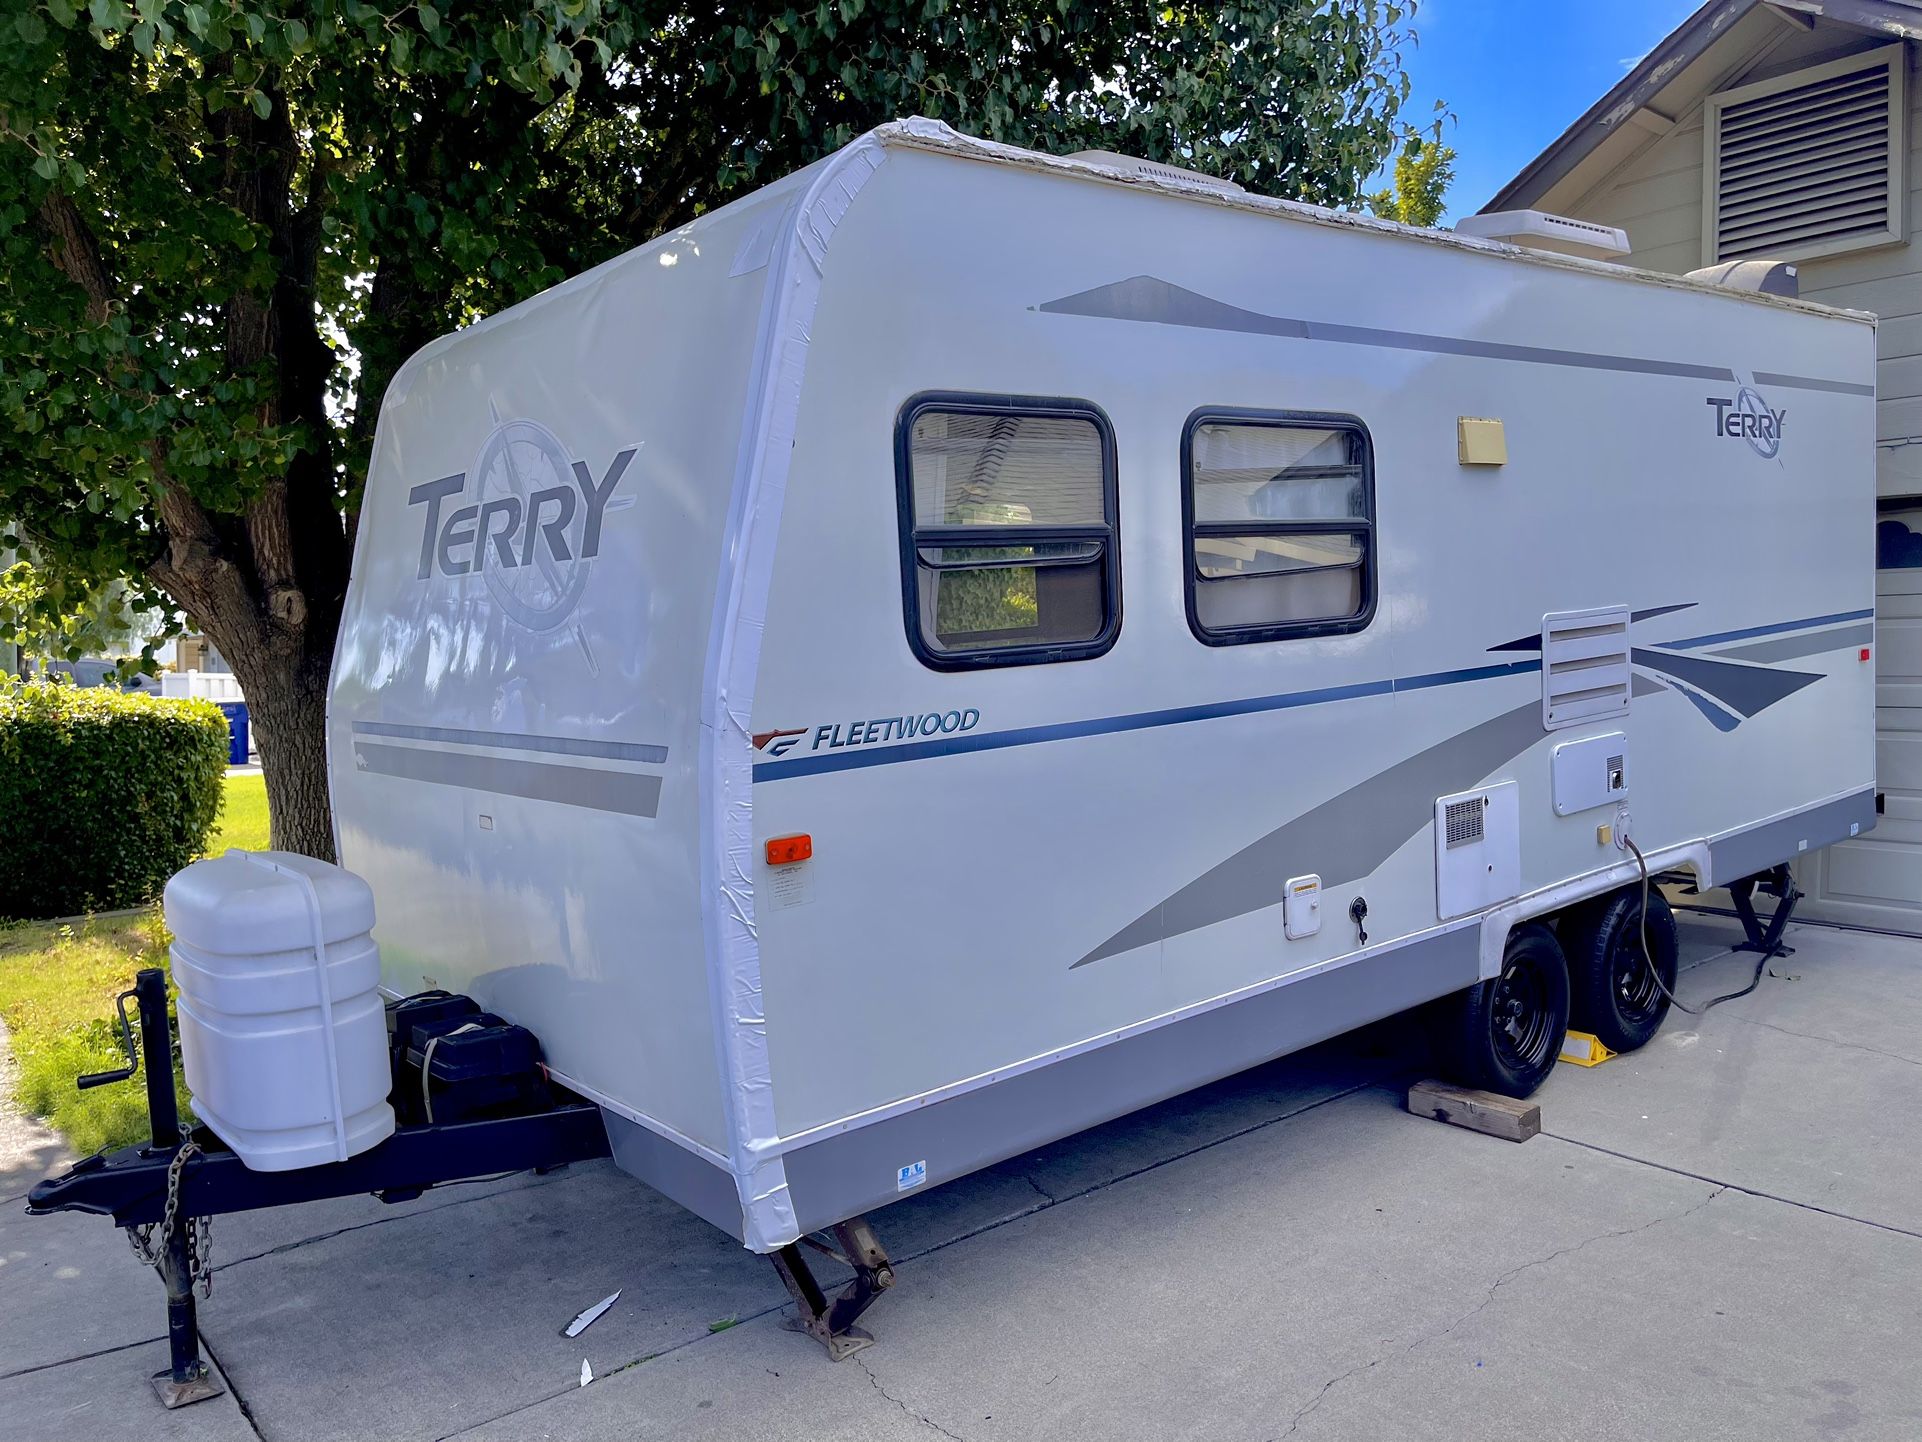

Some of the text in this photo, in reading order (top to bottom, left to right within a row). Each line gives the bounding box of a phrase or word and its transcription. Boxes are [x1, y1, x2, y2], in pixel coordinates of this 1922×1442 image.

[1706, 397, 1786, 439] TERRY
[408, 448, 638, 580] TERRY
[811, 708, 980, 750] FLEETWOOD
